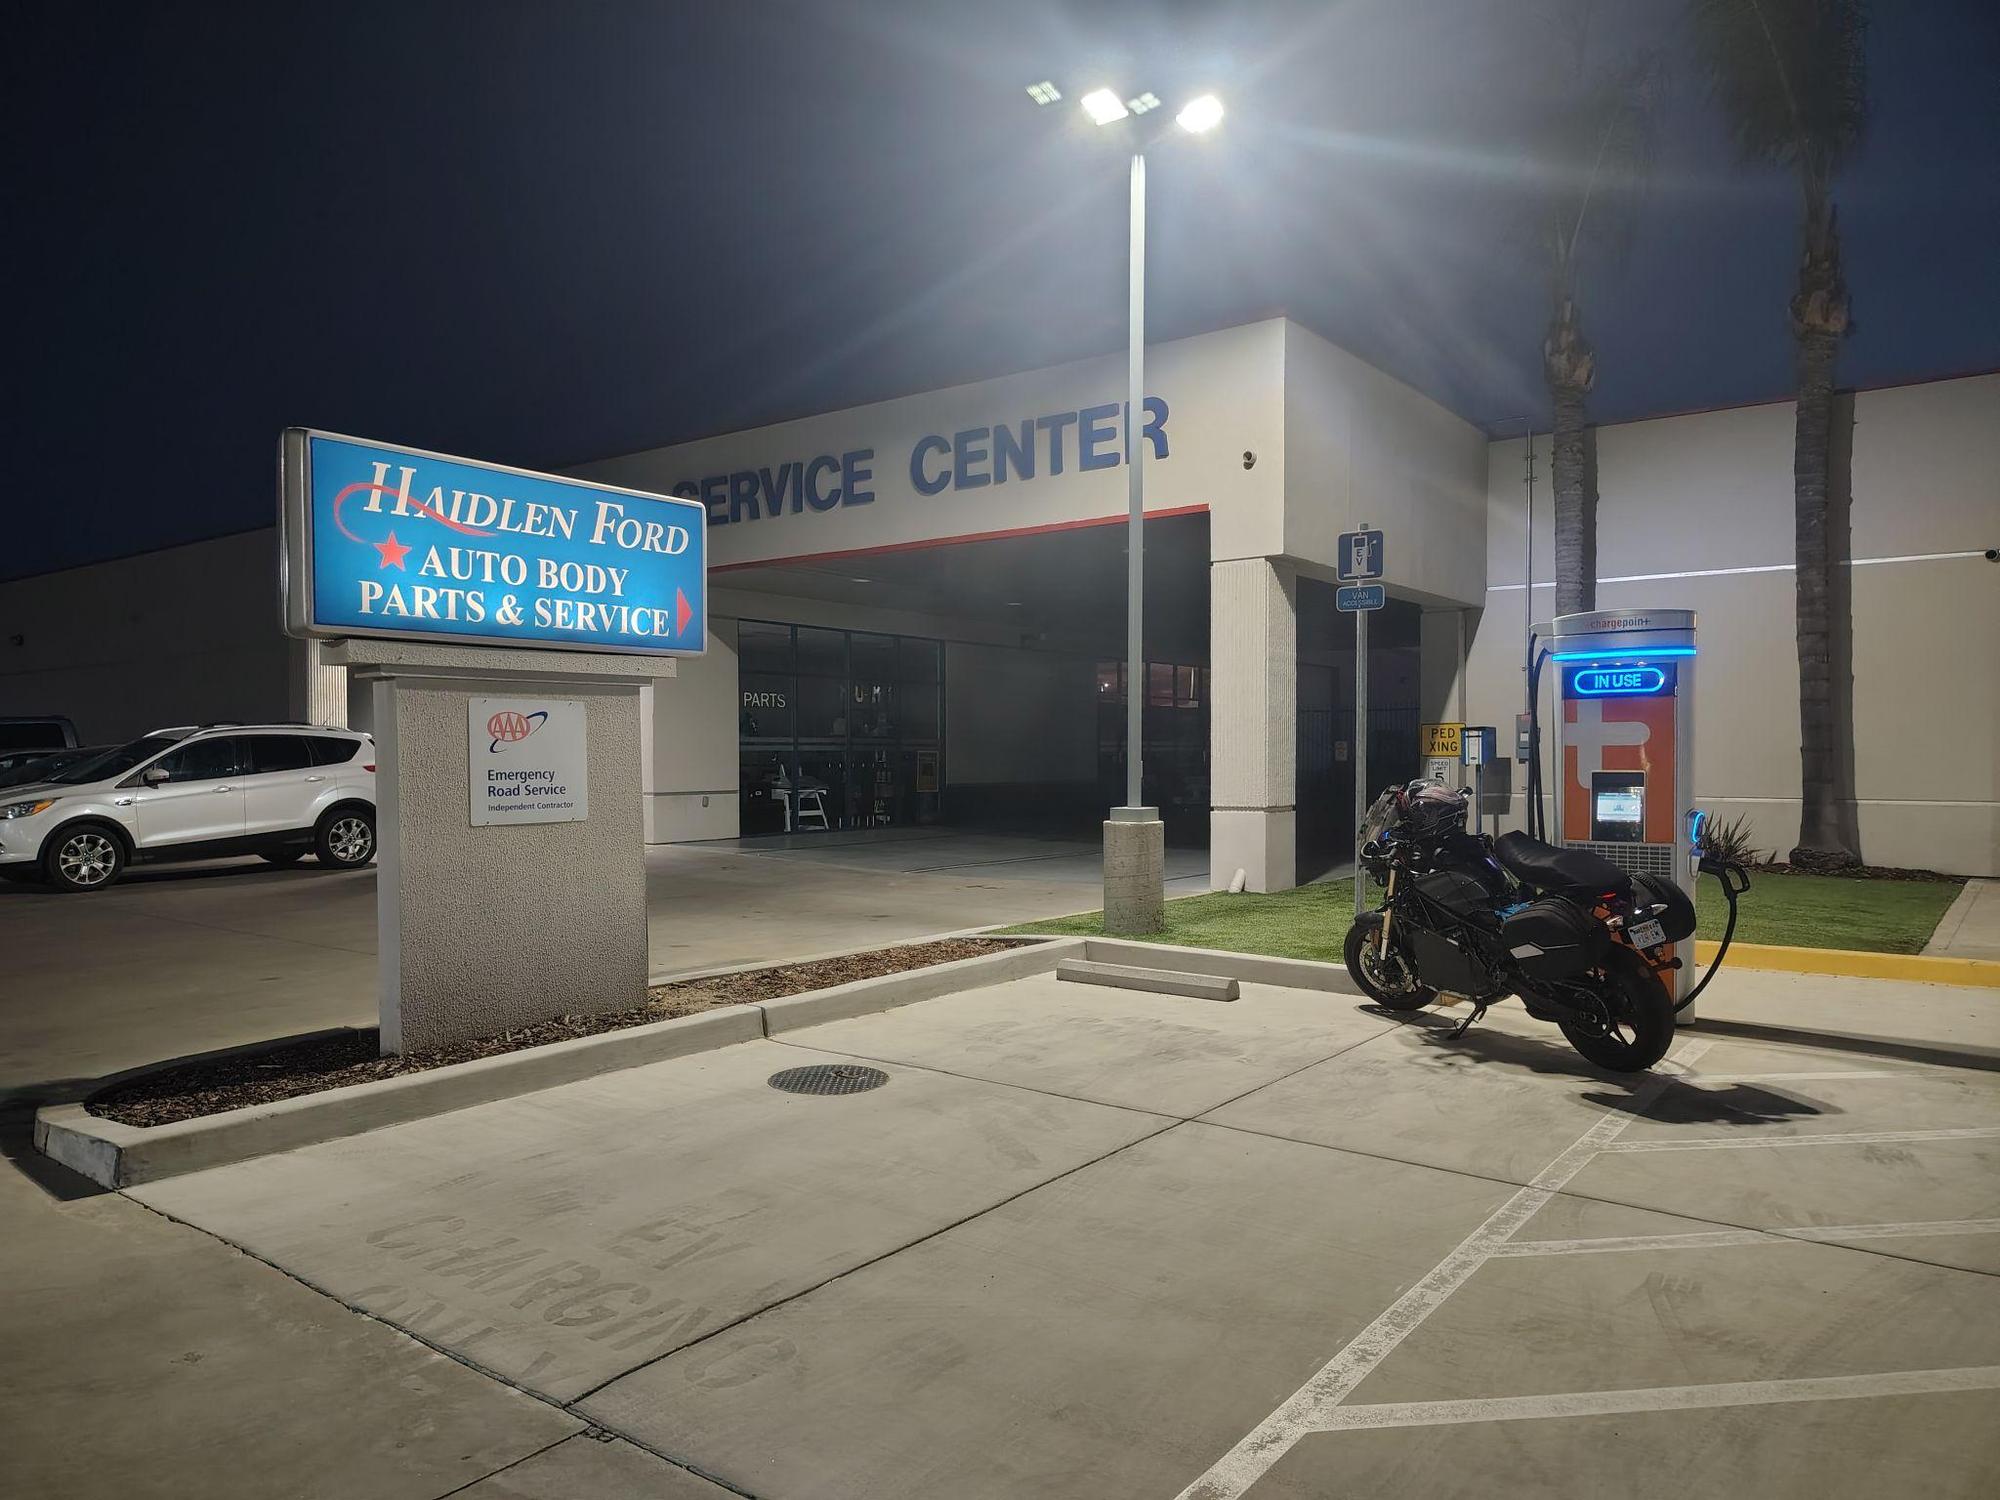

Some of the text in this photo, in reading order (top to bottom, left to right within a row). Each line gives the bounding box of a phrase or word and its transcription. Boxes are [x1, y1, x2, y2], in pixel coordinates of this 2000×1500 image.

[910, 396, 1170, 497] CENTER
[363, 461, 690, 556] HAIDLEN FORD
[1356, 548, 1363, 566] EV
[418, 544, 629, 597] AUTO BODY
[1352, 590, 1369, 600] VAN
[358, 580, 671, 638] PARTS & SERVICE
[1594, 673, 1642, 688] IN USE
[743, 691, 786, 708] PARTS
[492, 712, 528, 740] AAA
[1431, 727, 1455, 739] PED
[1429, 741, 1458, 752] XING
[487, 769, 555, 783] Emergency
[488, 783, 567, 798] Road Service
[488, 801, 574, 813] Independent Contractor
